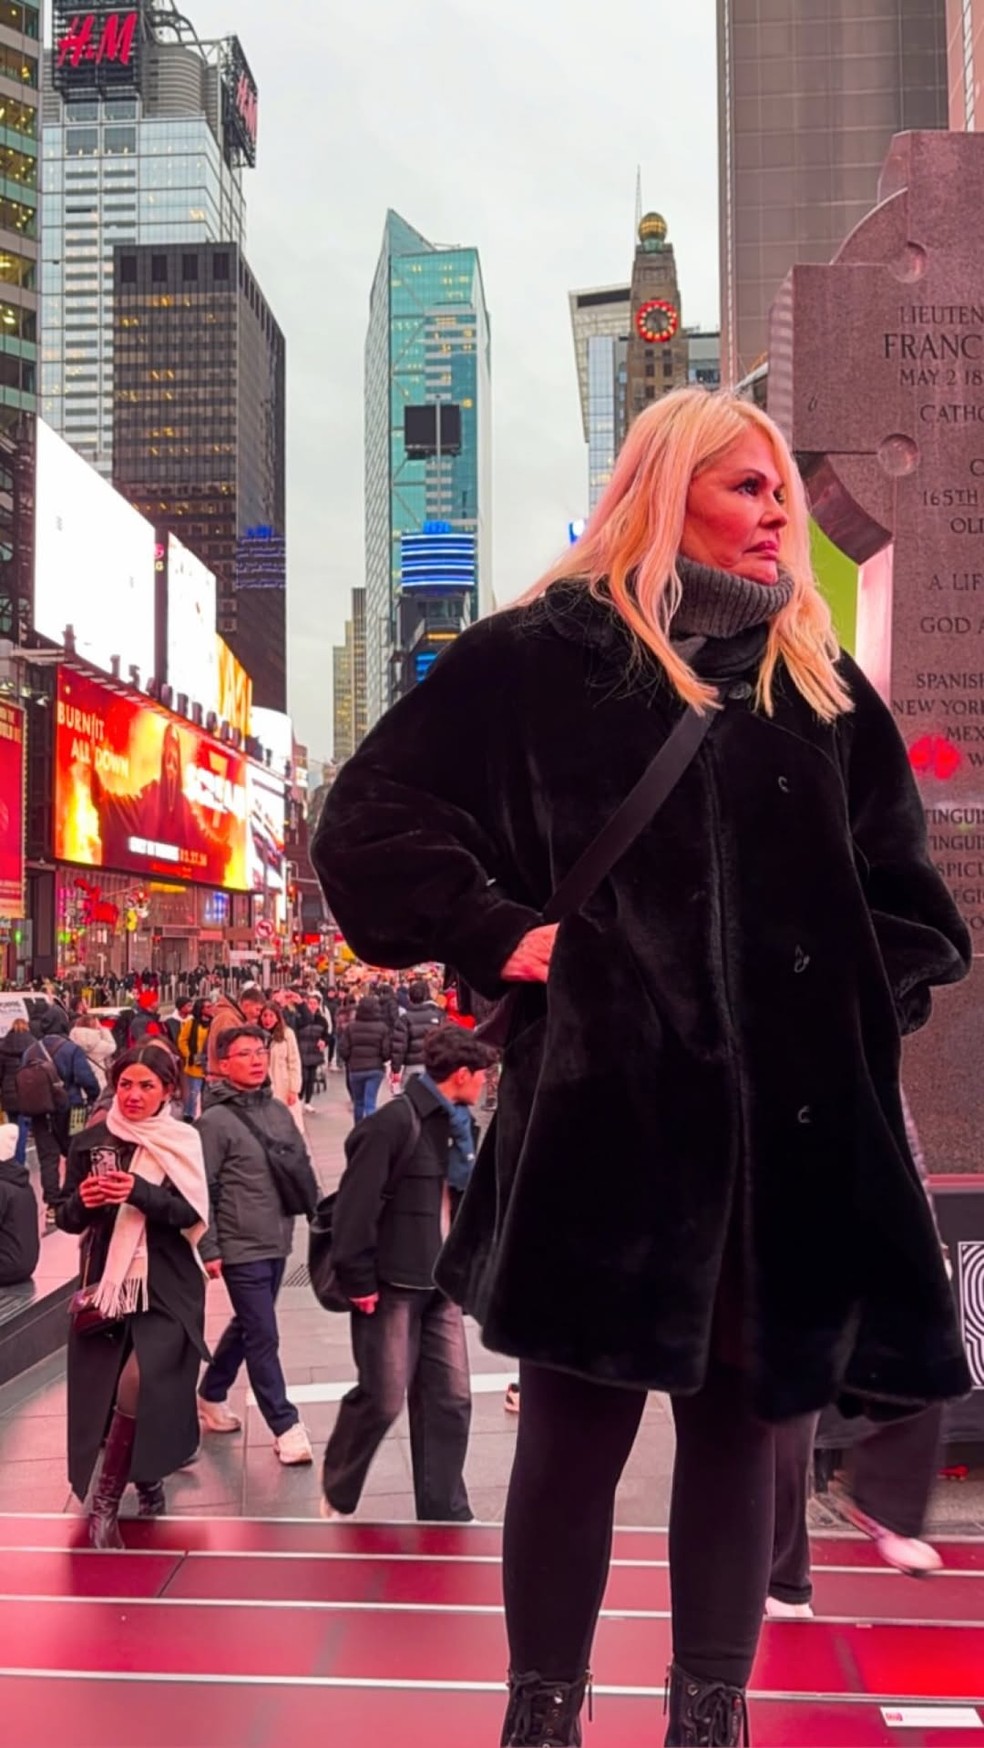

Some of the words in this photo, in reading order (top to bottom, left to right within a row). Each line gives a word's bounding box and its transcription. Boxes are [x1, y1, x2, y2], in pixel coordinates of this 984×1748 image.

[884, 333, 983, 360] FRANC
[900, 369, 939, 386] MAY
[946, 369, 956, 386] 2
[929, 574, 943, 591] A
[920, 616, 972, 634] GOD
[891, 699, 935, 716] NEW
[71, 737, 91, 764] ALL
